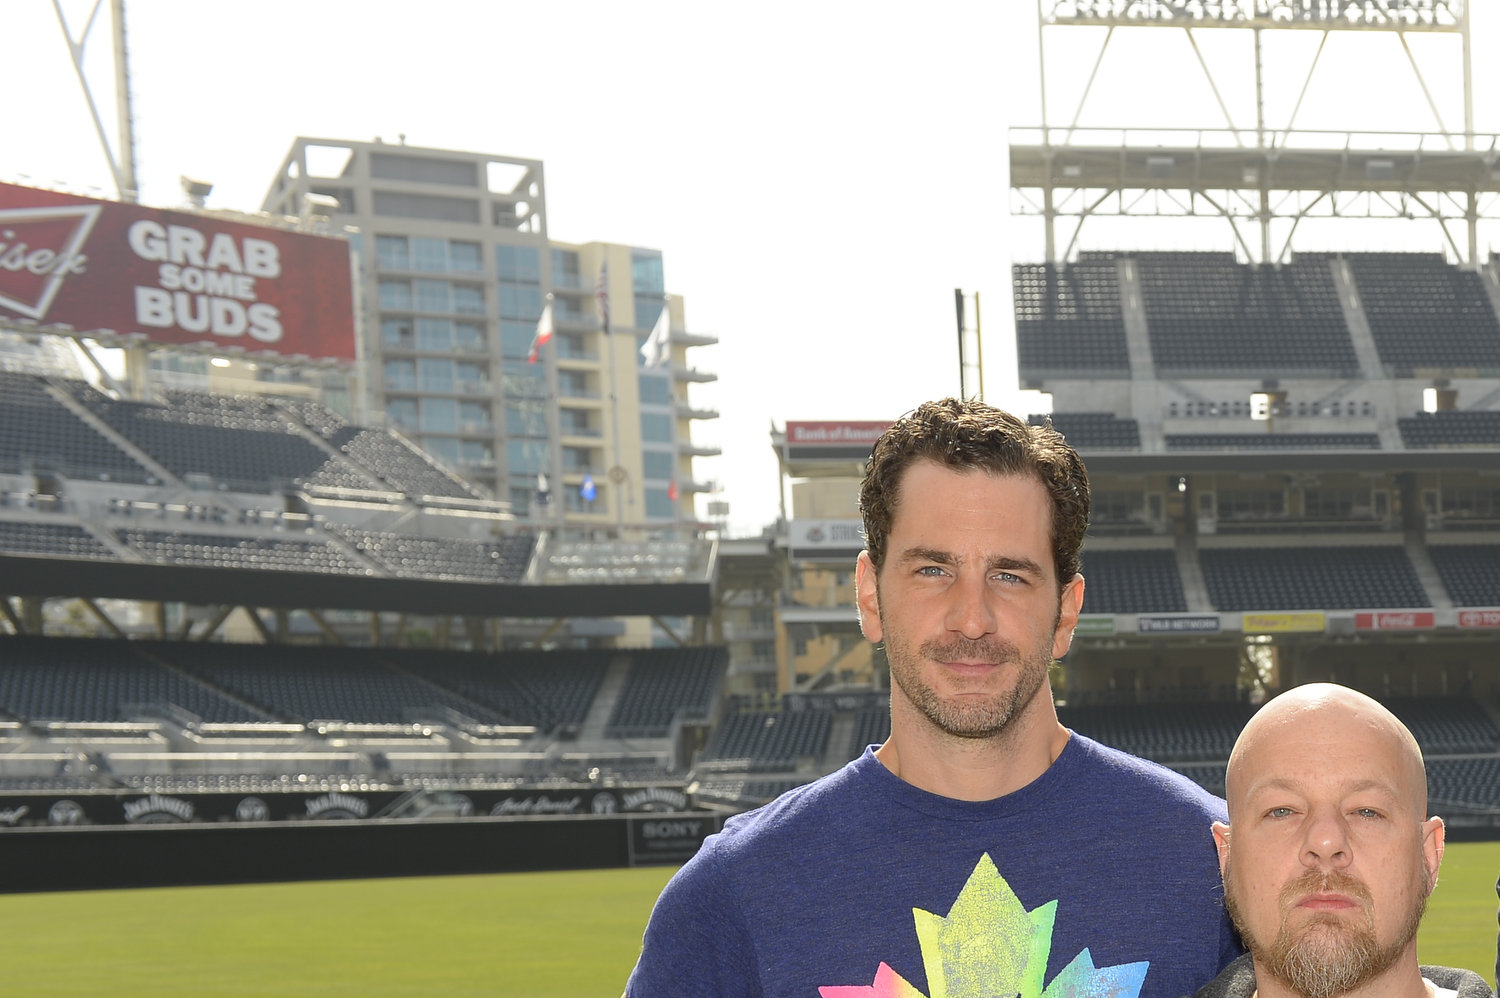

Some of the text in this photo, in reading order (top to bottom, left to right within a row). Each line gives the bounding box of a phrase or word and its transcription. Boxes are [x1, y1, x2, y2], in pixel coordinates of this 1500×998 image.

[127, 219, 282, 279] GRAB
[158, 263, 258, 301] SOME
[134, 285, 284, 343] BUDS
[642, 822, 702, 838] SONY
